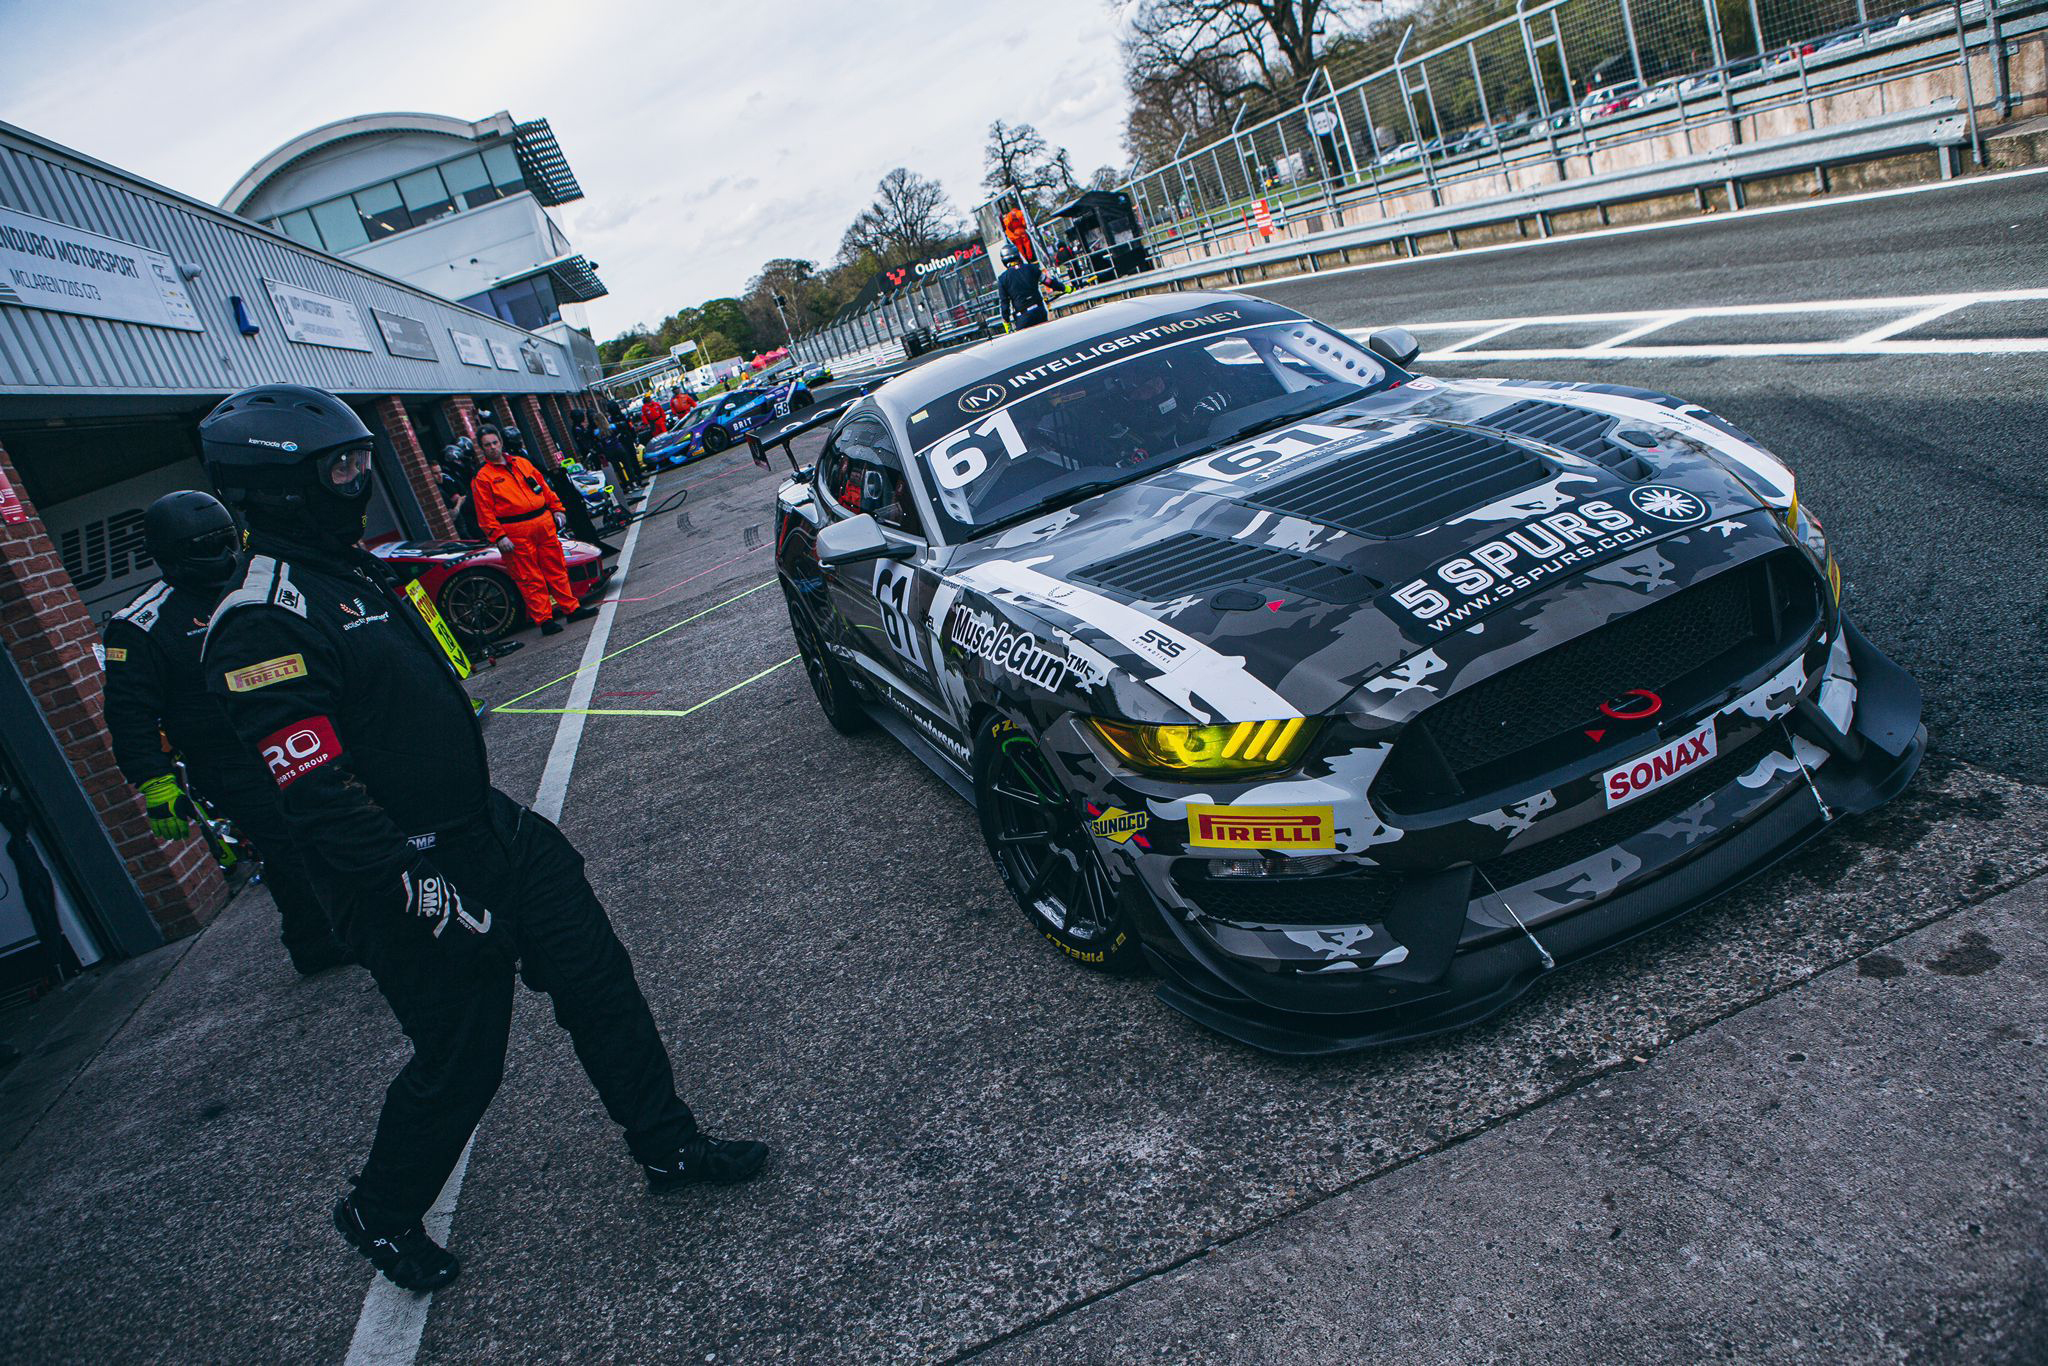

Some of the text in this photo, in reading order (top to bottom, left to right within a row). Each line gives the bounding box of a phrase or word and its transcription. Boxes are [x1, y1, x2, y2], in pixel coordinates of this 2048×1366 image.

[53, 238, 140, 279] MOTORSPORT
[9, 268, 101, 301] MCLAREN 720S GT3
[732, 417, 752, 431] BRIT
[775, 402, 789, 417] 68
[930, 409, 1028, 489] 61
[1208, 429, 1336, 475] 61
[1391, 500, 1635, 619] 5 SPURS
[1427, 525, 1653, 632] WWW.5SPURS.COM
[282, 590, 297, 607] OMP
[876, 568, 917, 661] 61
[951, 604, 1068, 693] MuscleGun
[1139, 629, 1187, 658] SRS
[234, 658, 299, 689] PIRELLI
[298, 753, 329, 772] GROUP
[1609, 730, 1709, 800] SONAX
[1093, 813, 1147, 838] SUNOCO
[1198, 814, 1321, 842] PIRELLI
[423, 877, 438, 918] OMP
[1045, 933, 1105, 963] PIRELLI
